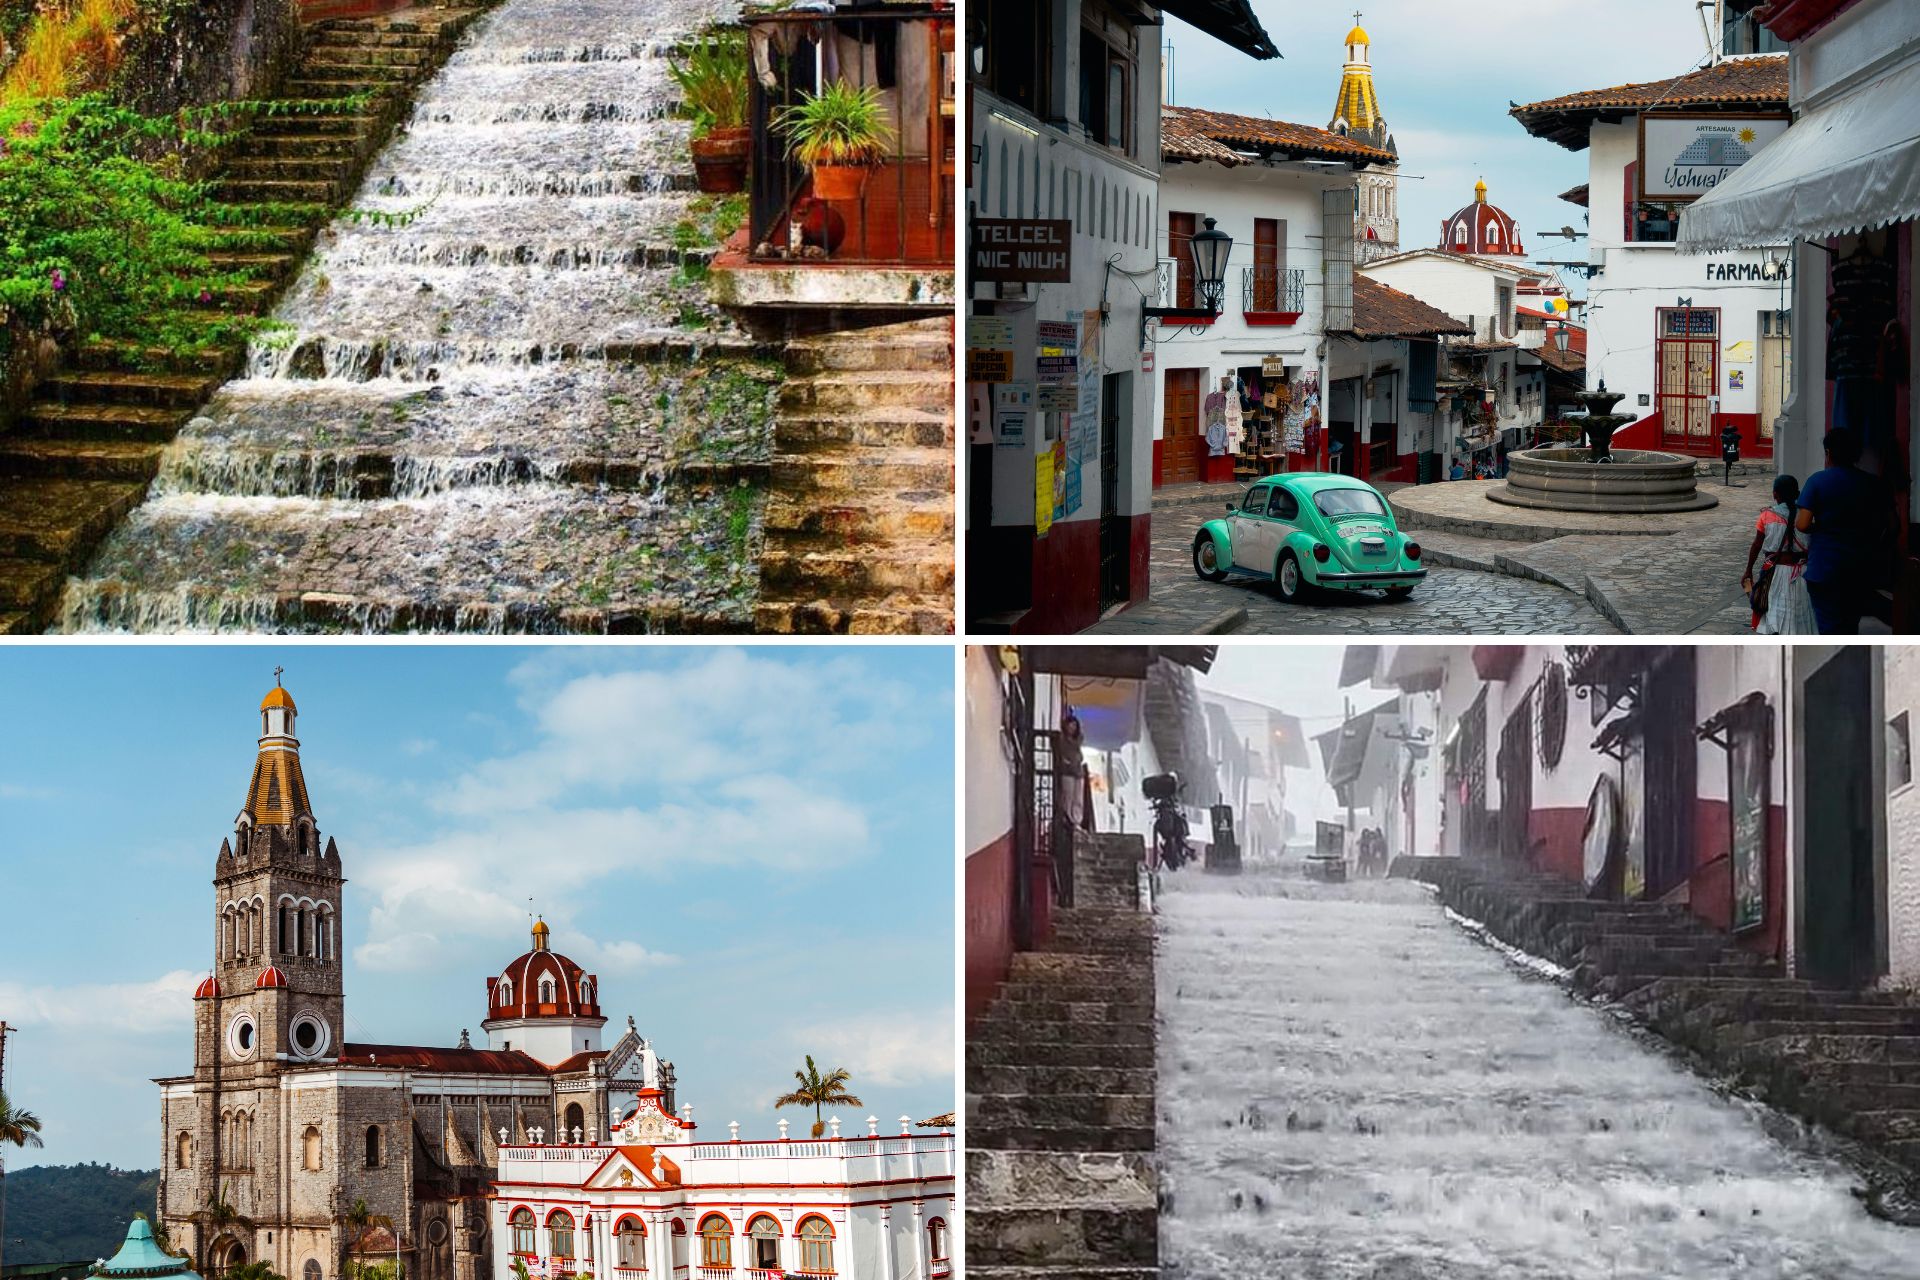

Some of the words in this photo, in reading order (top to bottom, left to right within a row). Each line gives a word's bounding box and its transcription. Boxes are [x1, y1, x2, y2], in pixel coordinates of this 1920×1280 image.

[977, 225, 1062, 244] TELCEL
[976, 250, 1011, 268] NIC
[1017, 251, 1066, 269] NIUH
[1706, 263, 1788, 281] FARMACA
[1039, 326, 1077, 336] INTERNET
[975, 352, 1004, 362] PRECIO
[971, 362, 1009, 372] ESPECIAL
